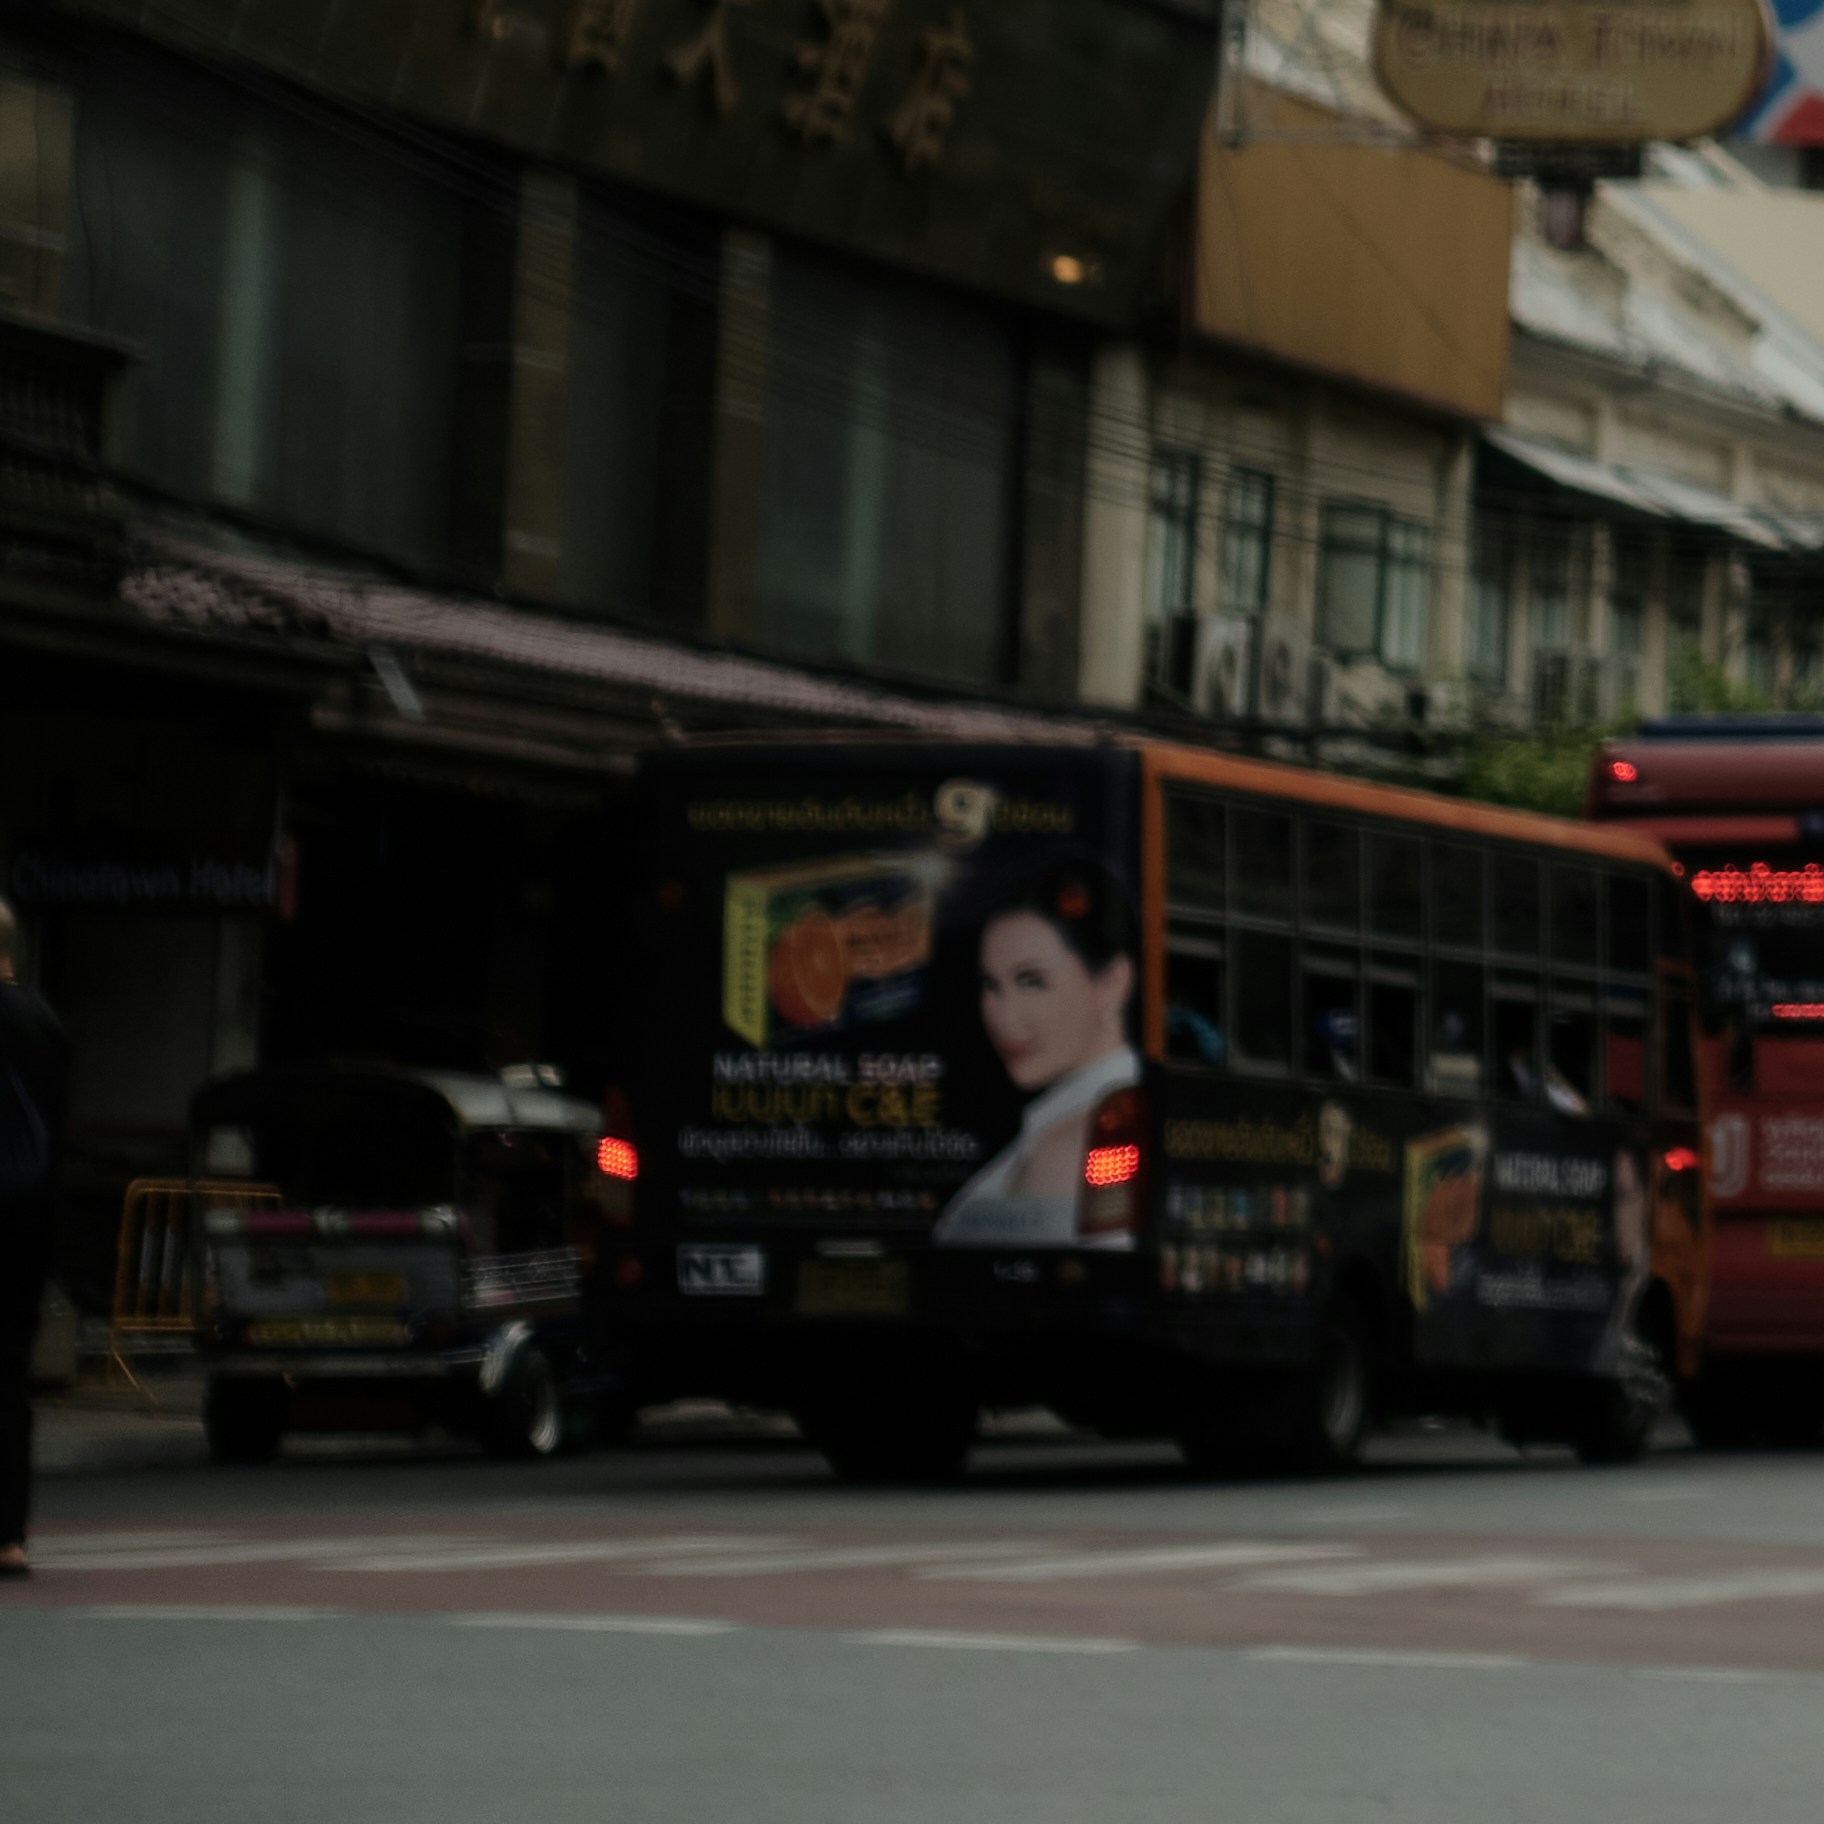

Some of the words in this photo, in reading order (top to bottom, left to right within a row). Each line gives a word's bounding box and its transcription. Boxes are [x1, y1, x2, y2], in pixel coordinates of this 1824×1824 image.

[932, 776, 998, 854] 9
[712, 1050, 852, 1086] NATURAL
[856, 1050, 948, 1086] SOAP
[844, 1083, 946, 1128] C&E
